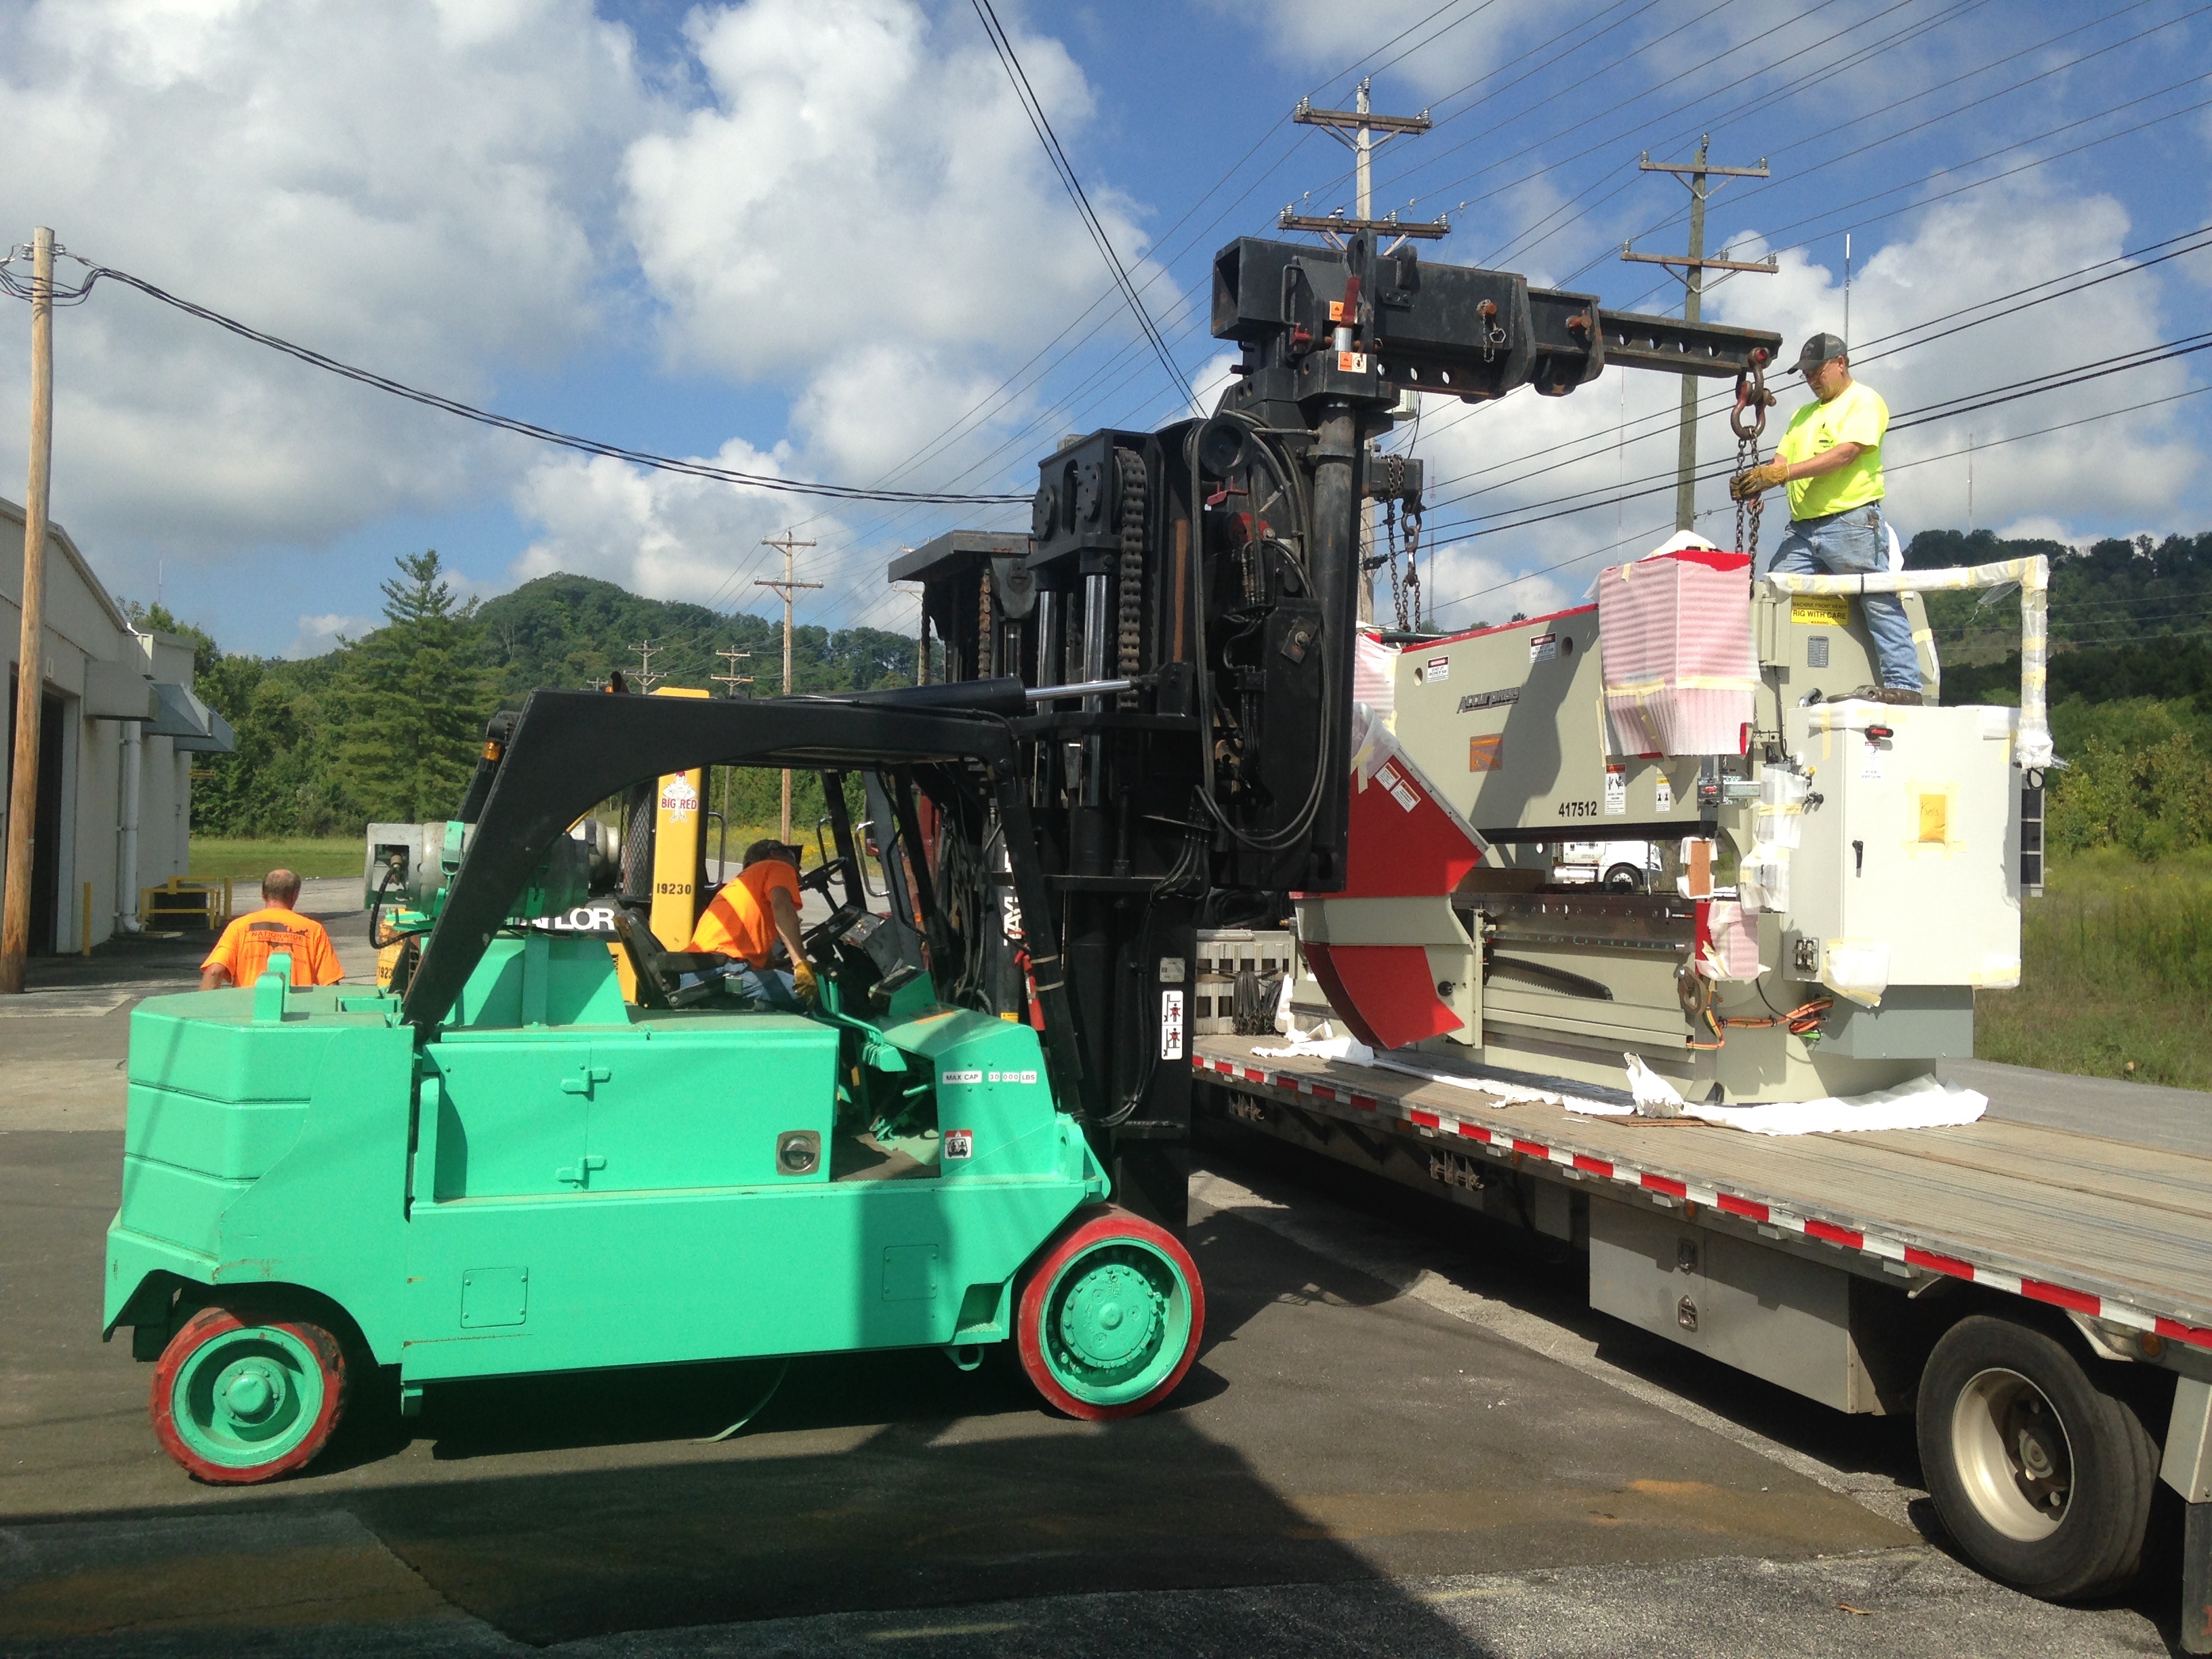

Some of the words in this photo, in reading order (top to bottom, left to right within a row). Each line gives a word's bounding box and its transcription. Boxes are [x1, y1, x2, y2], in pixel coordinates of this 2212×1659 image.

[661, 798, 676, 808] BIG
[680, 799, 697, 810] RED
[1559, 800, 1597, 817] 417512
[657, 883, 691, 895] 19230
[251, 932, 303, 942] NATIONWIDE
